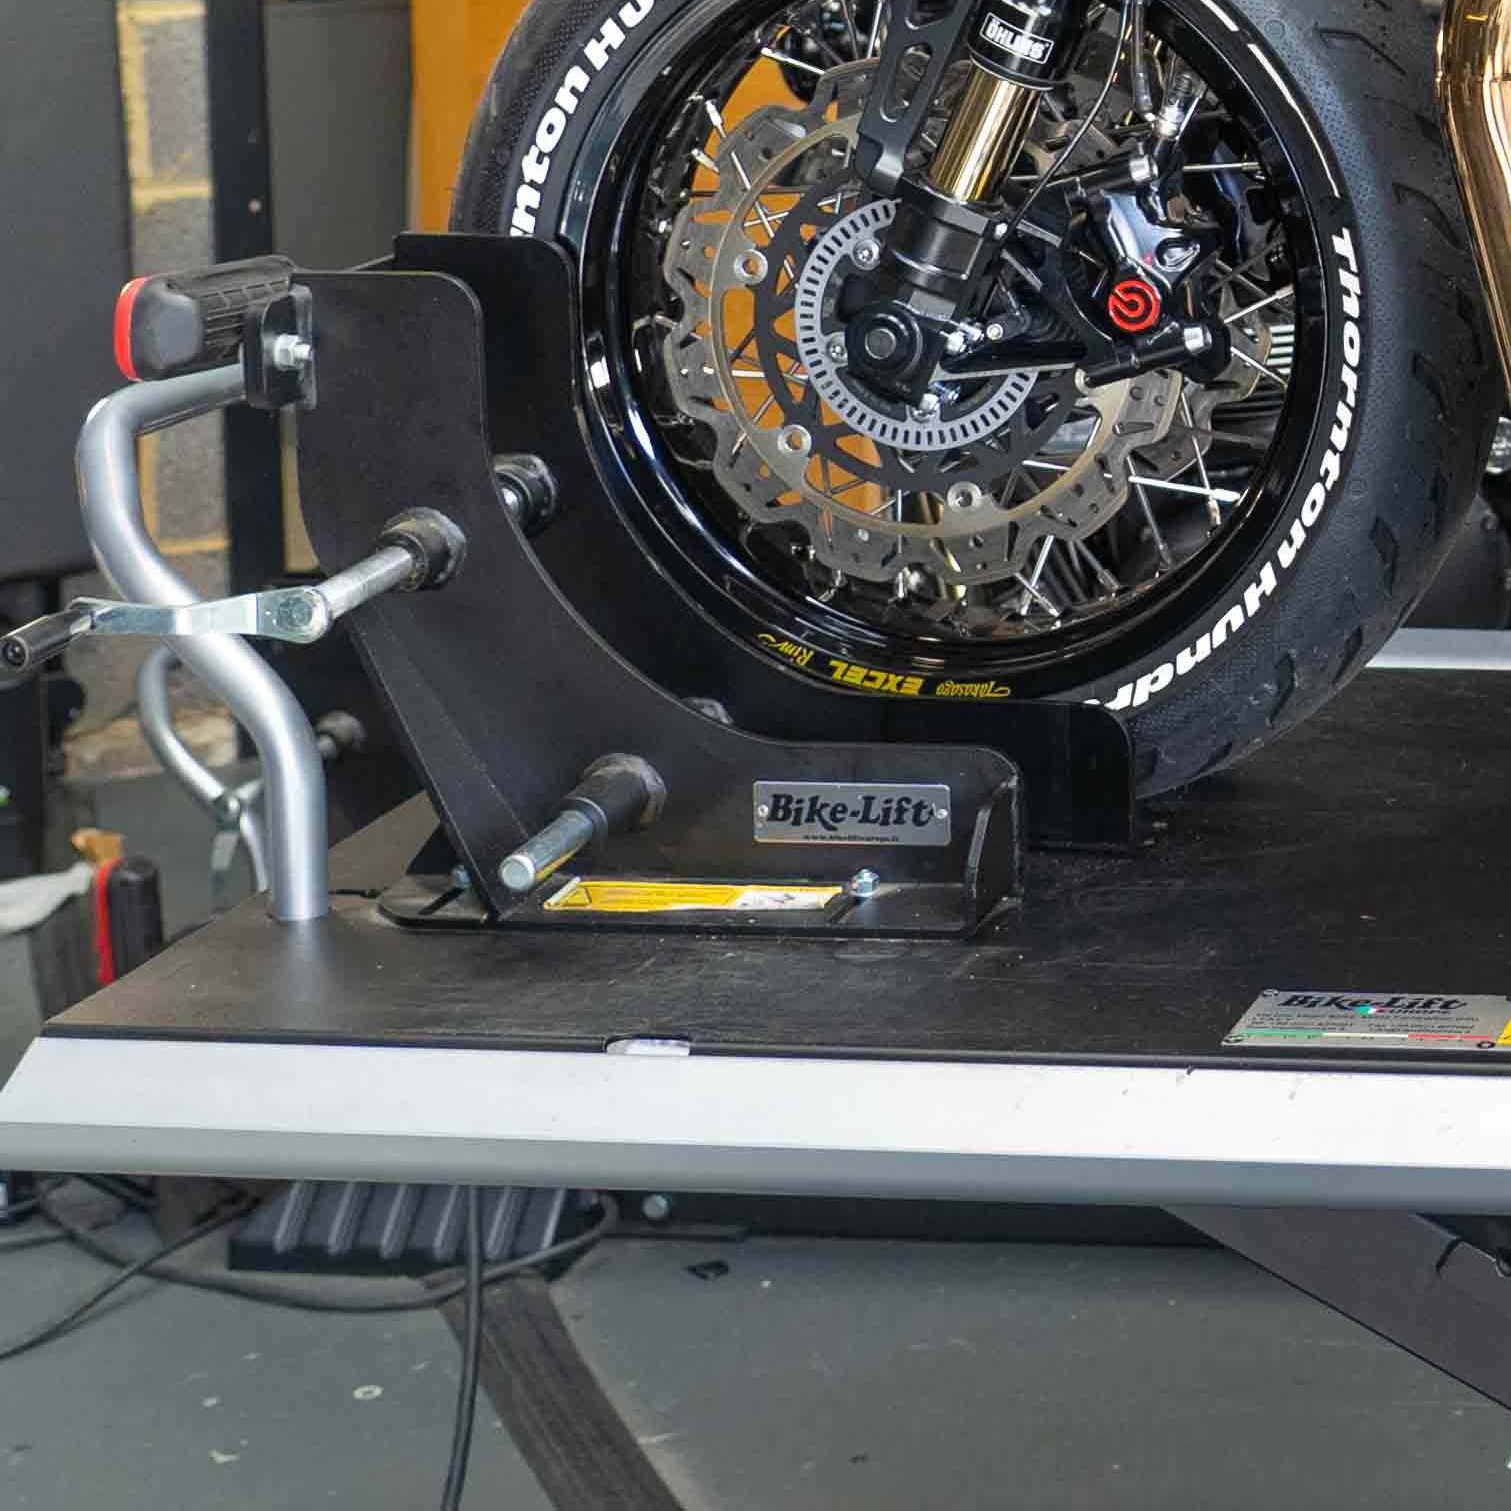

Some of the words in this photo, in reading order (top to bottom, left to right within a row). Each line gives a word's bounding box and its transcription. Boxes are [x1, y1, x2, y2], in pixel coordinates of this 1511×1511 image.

[1277, 226, 1364, 572] Thornton
[1085, 561, 1278, 711] Hundr
[829, 659, 926, 697] EXCEL
[767, 792, 936, 832] Bike-Lift
[1277, 993, 1468, 1010] Bike-Lift
